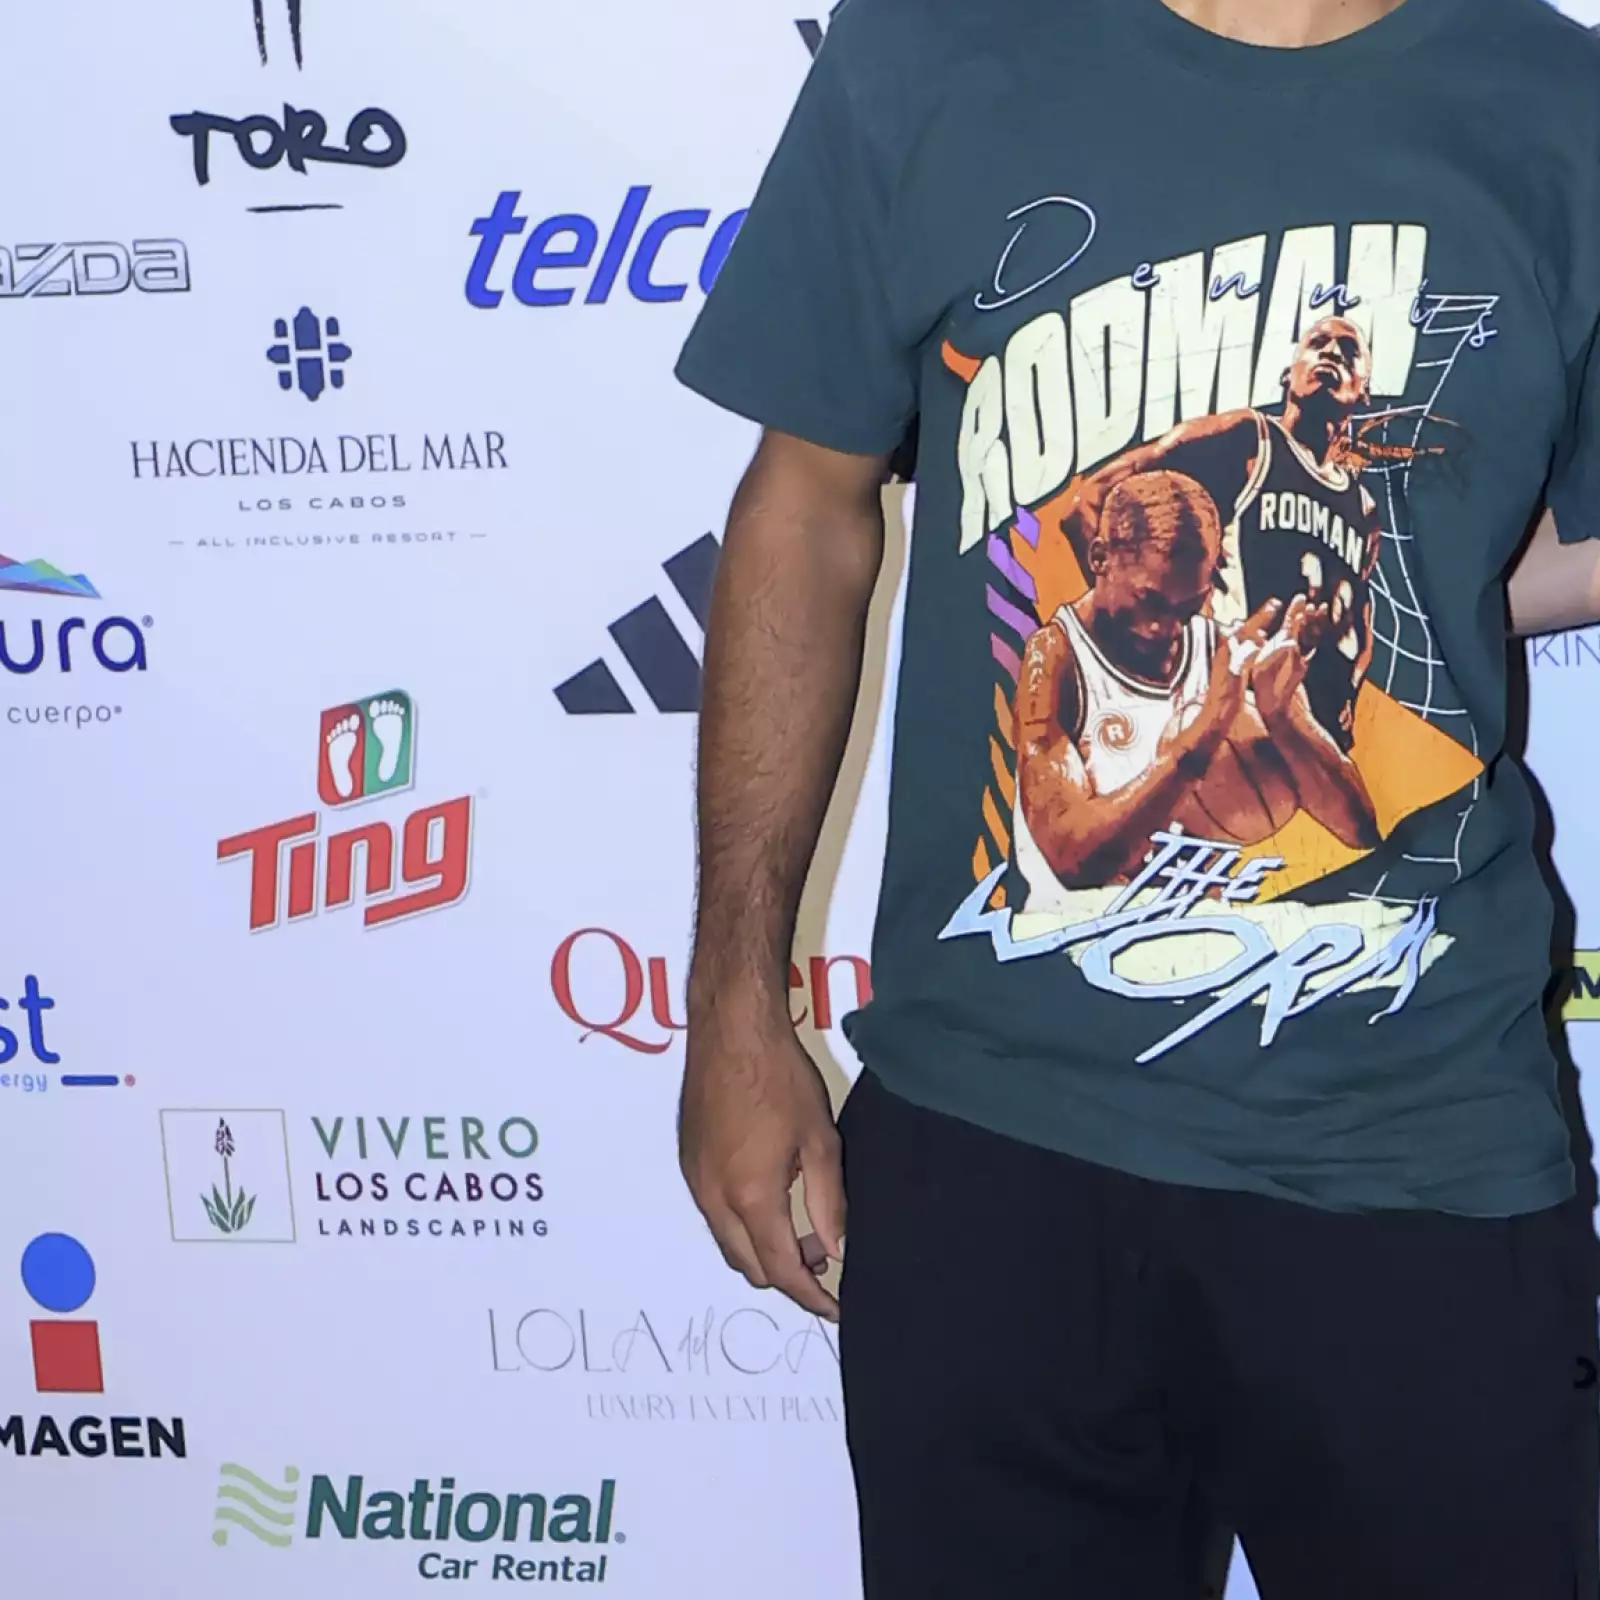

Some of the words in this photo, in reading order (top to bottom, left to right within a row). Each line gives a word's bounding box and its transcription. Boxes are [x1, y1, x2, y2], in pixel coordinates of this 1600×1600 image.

[170, 103, 407, 185] TORO
[464, 185, 745, 309] telc
[958, 224, 1427, 555] RODMAN
[130, 436, 329, 478] HACIENDA
[339, 433, 412, 473] DEL
[422, 430, 508, 471] MAR
[238, 499, 293, 512] LOS
[309, 494, 407, 510] CABOS
[196, 537, 236, 548] ALL
[372, 531, 458, 544] RESORT
[1260, 491, 1363, 576] RODMAN
[7, 704, 110, 728] cuerpo
[217, 795, 471, 931] Ting
[1106, 828, 1283, 916] THE
[312, 1115, 539, 1161] VIVERO
[316, 1171, 389, 1202] LOS
[404, 1171, 545, 1203] CABOS
[318, 1218, 549, 1238] LANDSCAPING
[489, 1307, 673, 1374] LOLA
[305, 1474, 617, 1545] National
[418, 1551, 478, 1581] Car
[492, 1553, 606, 1584] Rental
